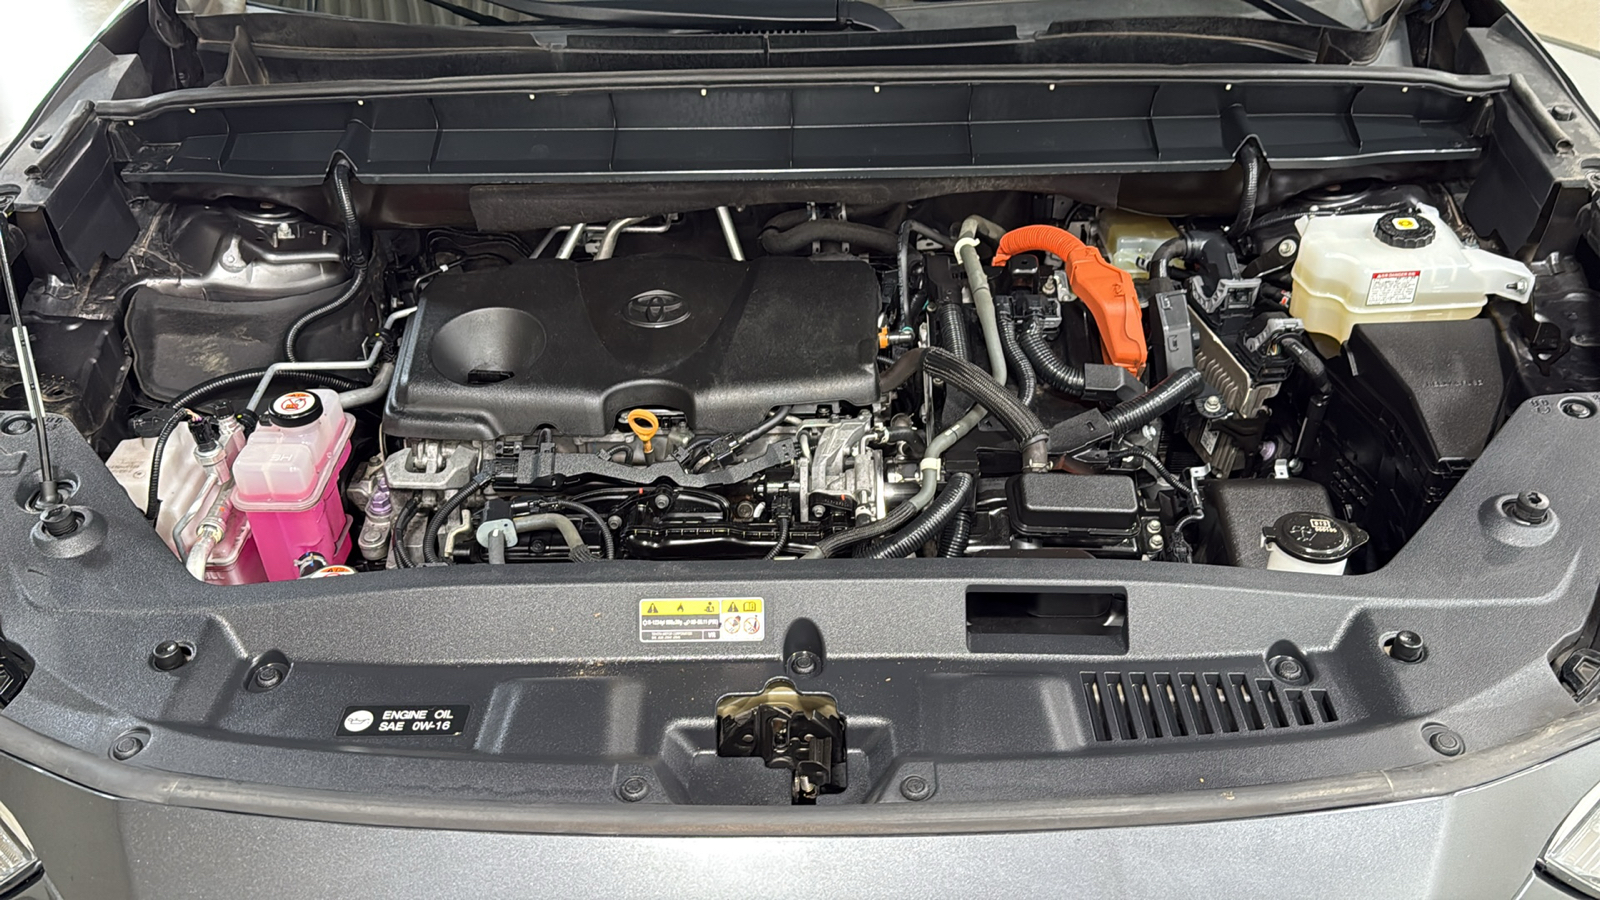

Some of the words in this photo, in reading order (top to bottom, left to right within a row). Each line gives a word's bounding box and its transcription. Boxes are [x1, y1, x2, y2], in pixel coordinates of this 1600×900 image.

[382, 710, 428, 720] ENGINE
[434, 709, 454, 719] OIL
[378, 721, 405, 731] SAE
[412, 721, 451, 731] 0W-16
